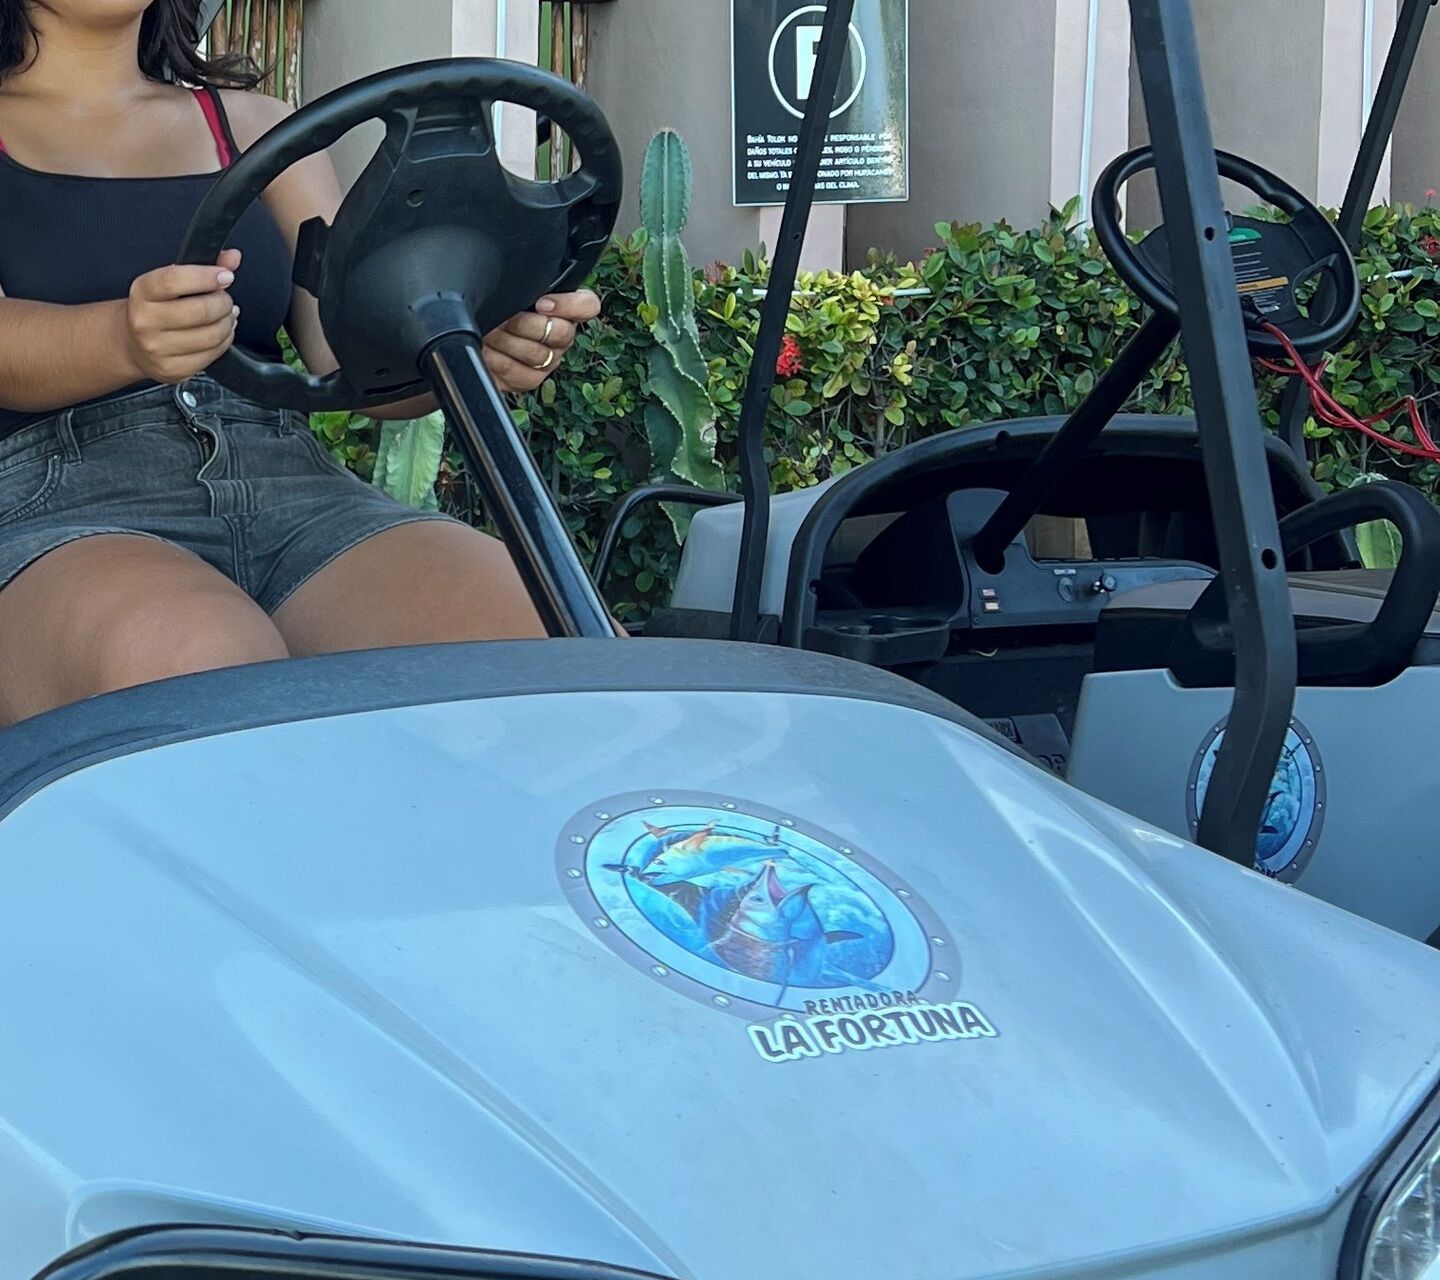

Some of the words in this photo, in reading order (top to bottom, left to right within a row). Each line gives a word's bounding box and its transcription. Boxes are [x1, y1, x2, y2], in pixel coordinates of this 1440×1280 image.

[830, 133, 875, 142] RESPONSABLE
[803, 989, 919, 1016] RENTADORA
[751, 1022, 815, 1059] LA
[812, 1005, 989, 1050] FORTUNA
